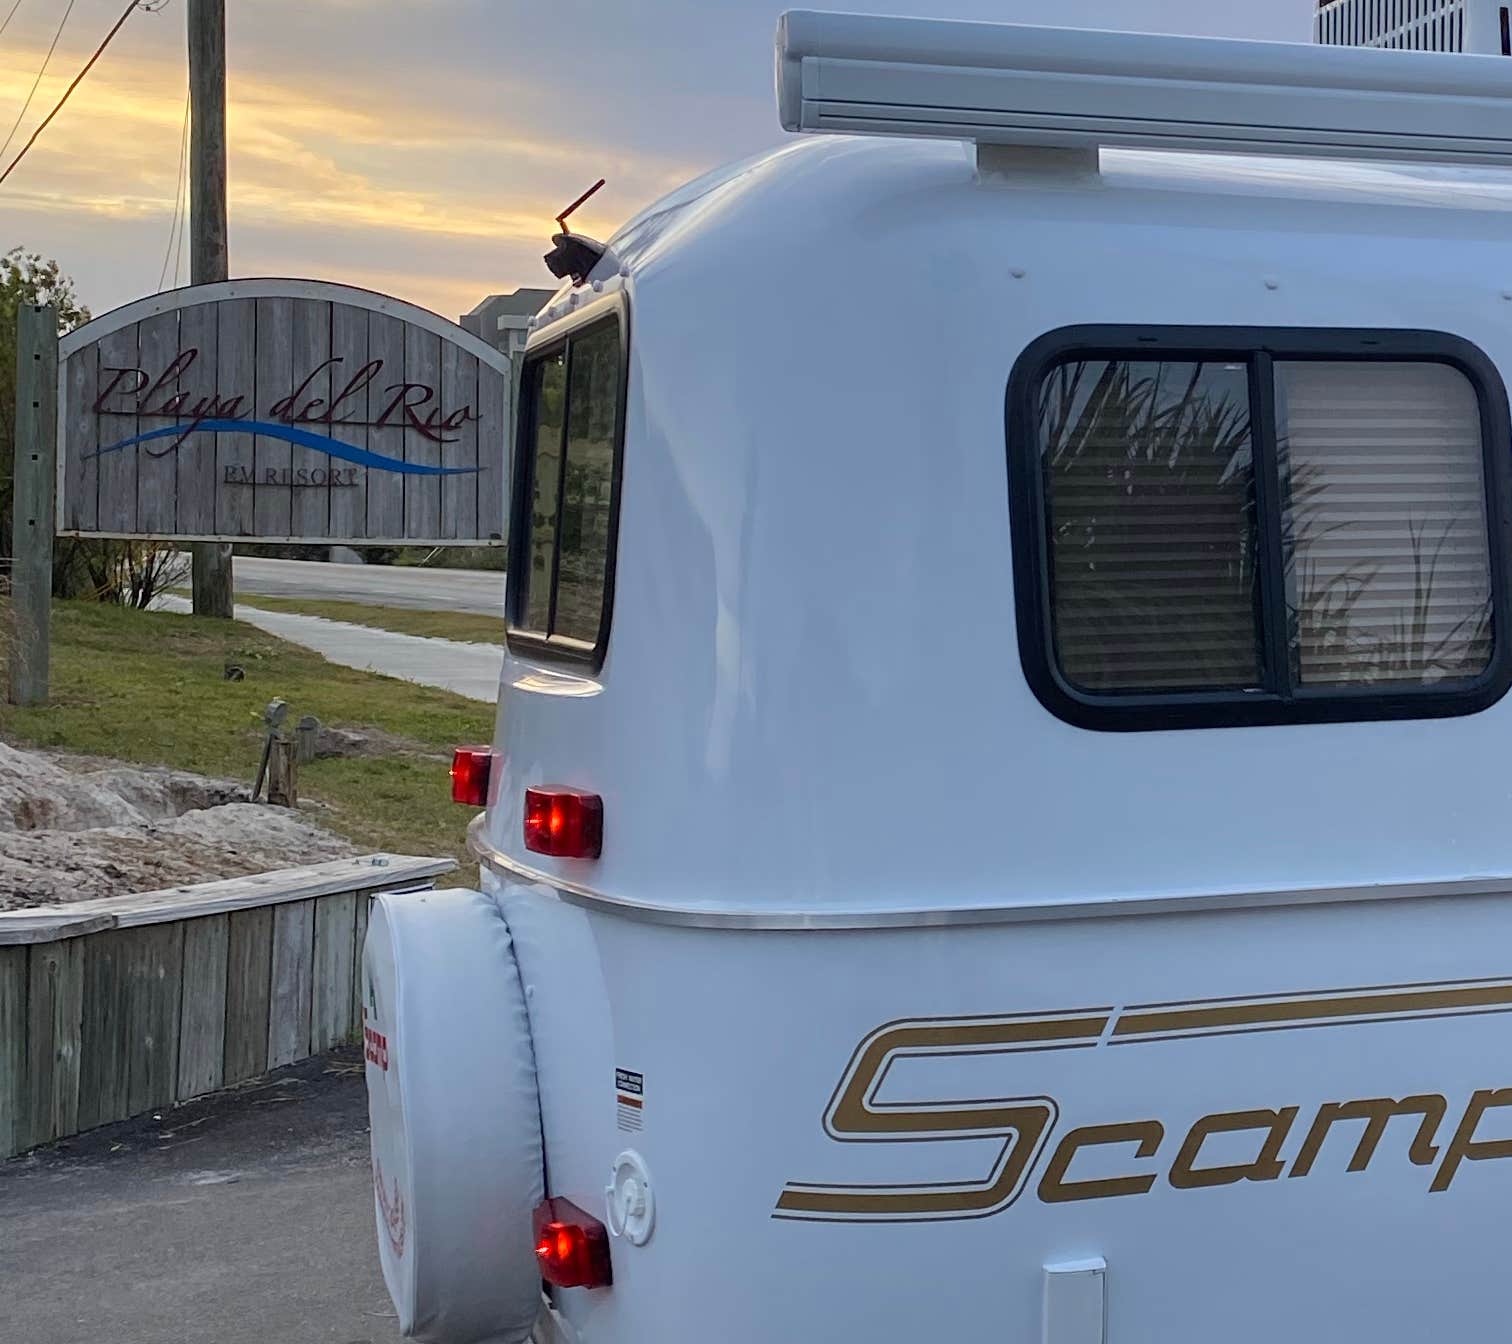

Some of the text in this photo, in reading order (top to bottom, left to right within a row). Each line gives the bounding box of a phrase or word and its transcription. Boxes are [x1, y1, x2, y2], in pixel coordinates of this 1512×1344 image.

[92, 348, 483, 457] Playa del Rio
[265, 467, 358, 486] RESORT
